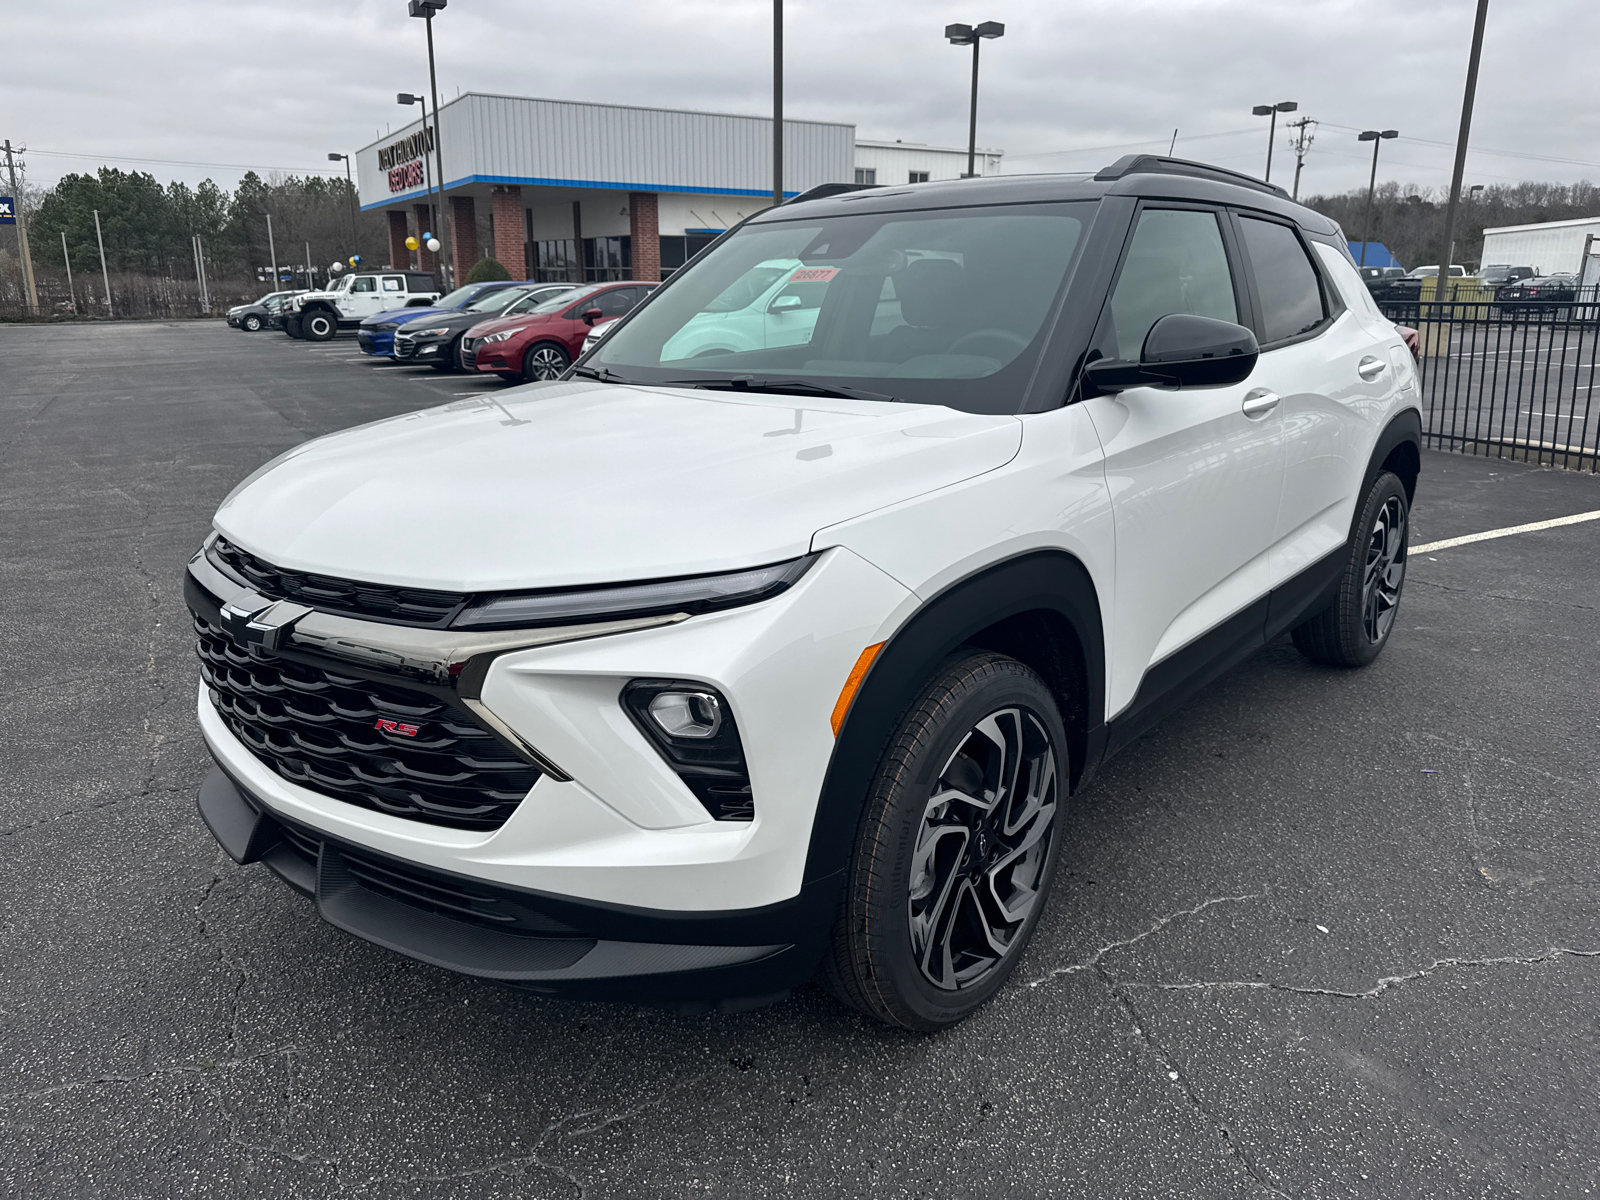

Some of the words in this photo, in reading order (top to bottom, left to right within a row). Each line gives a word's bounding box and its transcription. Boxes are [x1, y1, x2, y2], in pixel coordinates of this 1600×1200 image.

[378, 145, 396, 171] JOHN
[393, 126, 434, 165] THORNTON
[388, 167, 404, 191] USED
[403, 161, 423, 187] CARS
[795, 270, 833, 279] 26877
[375, 719, 420, 737] RS
